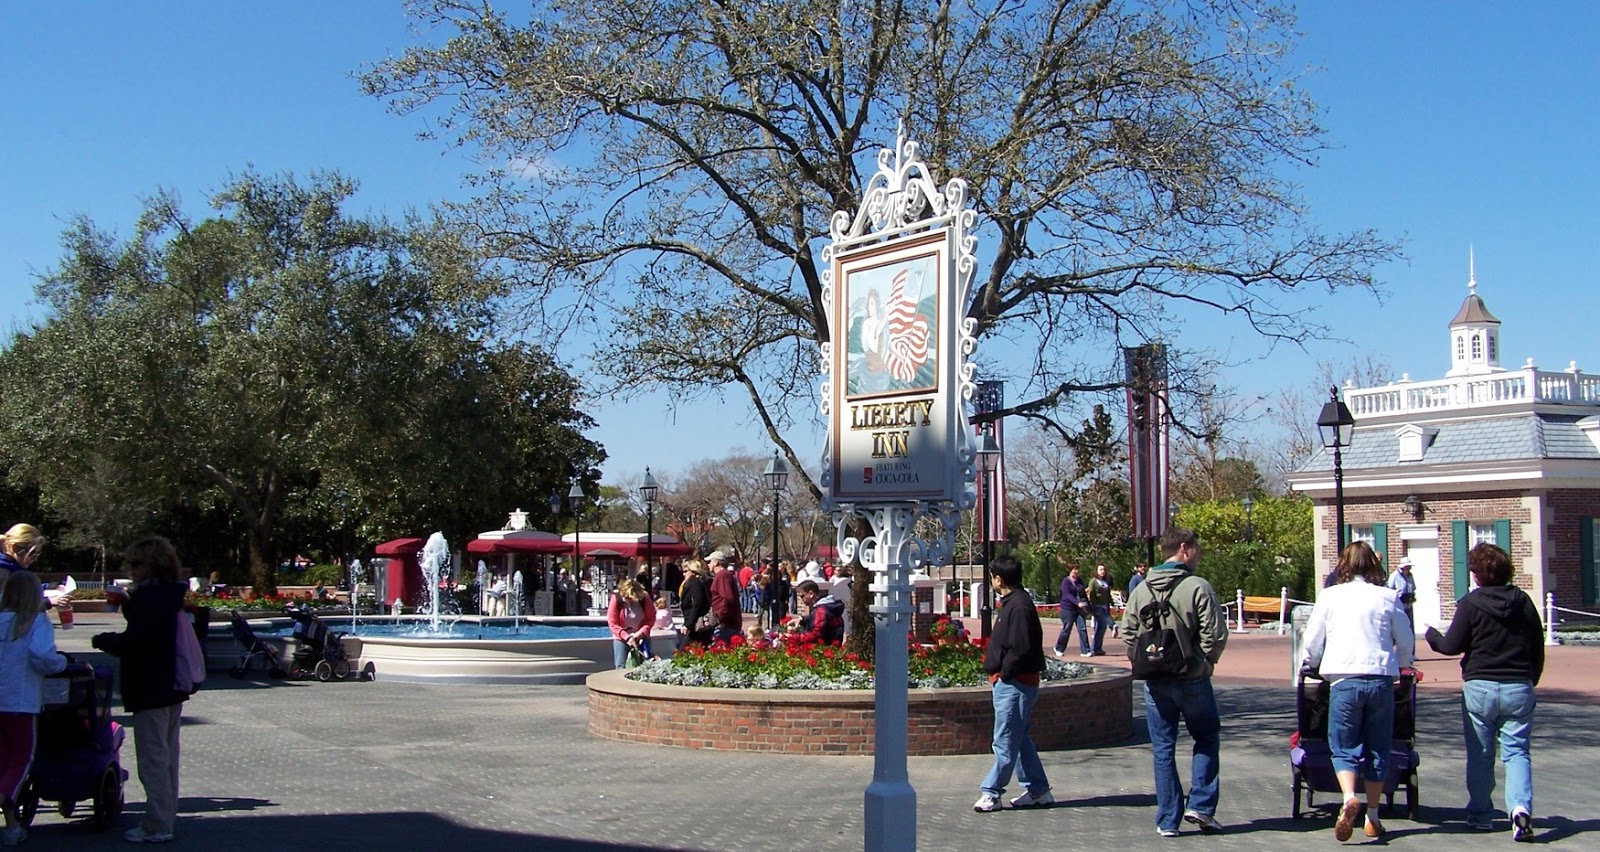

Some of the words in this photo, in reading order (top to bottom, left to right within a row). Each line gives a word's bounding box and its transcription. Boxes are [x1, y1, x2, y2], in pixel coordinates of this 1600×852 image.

[850, 399, 934, 430] LIBERTY
[872, 430, 909, 458] INN
[876, 462, 911, 471] FEATURING
[875, 472, 920, 484] COCA-COLA
